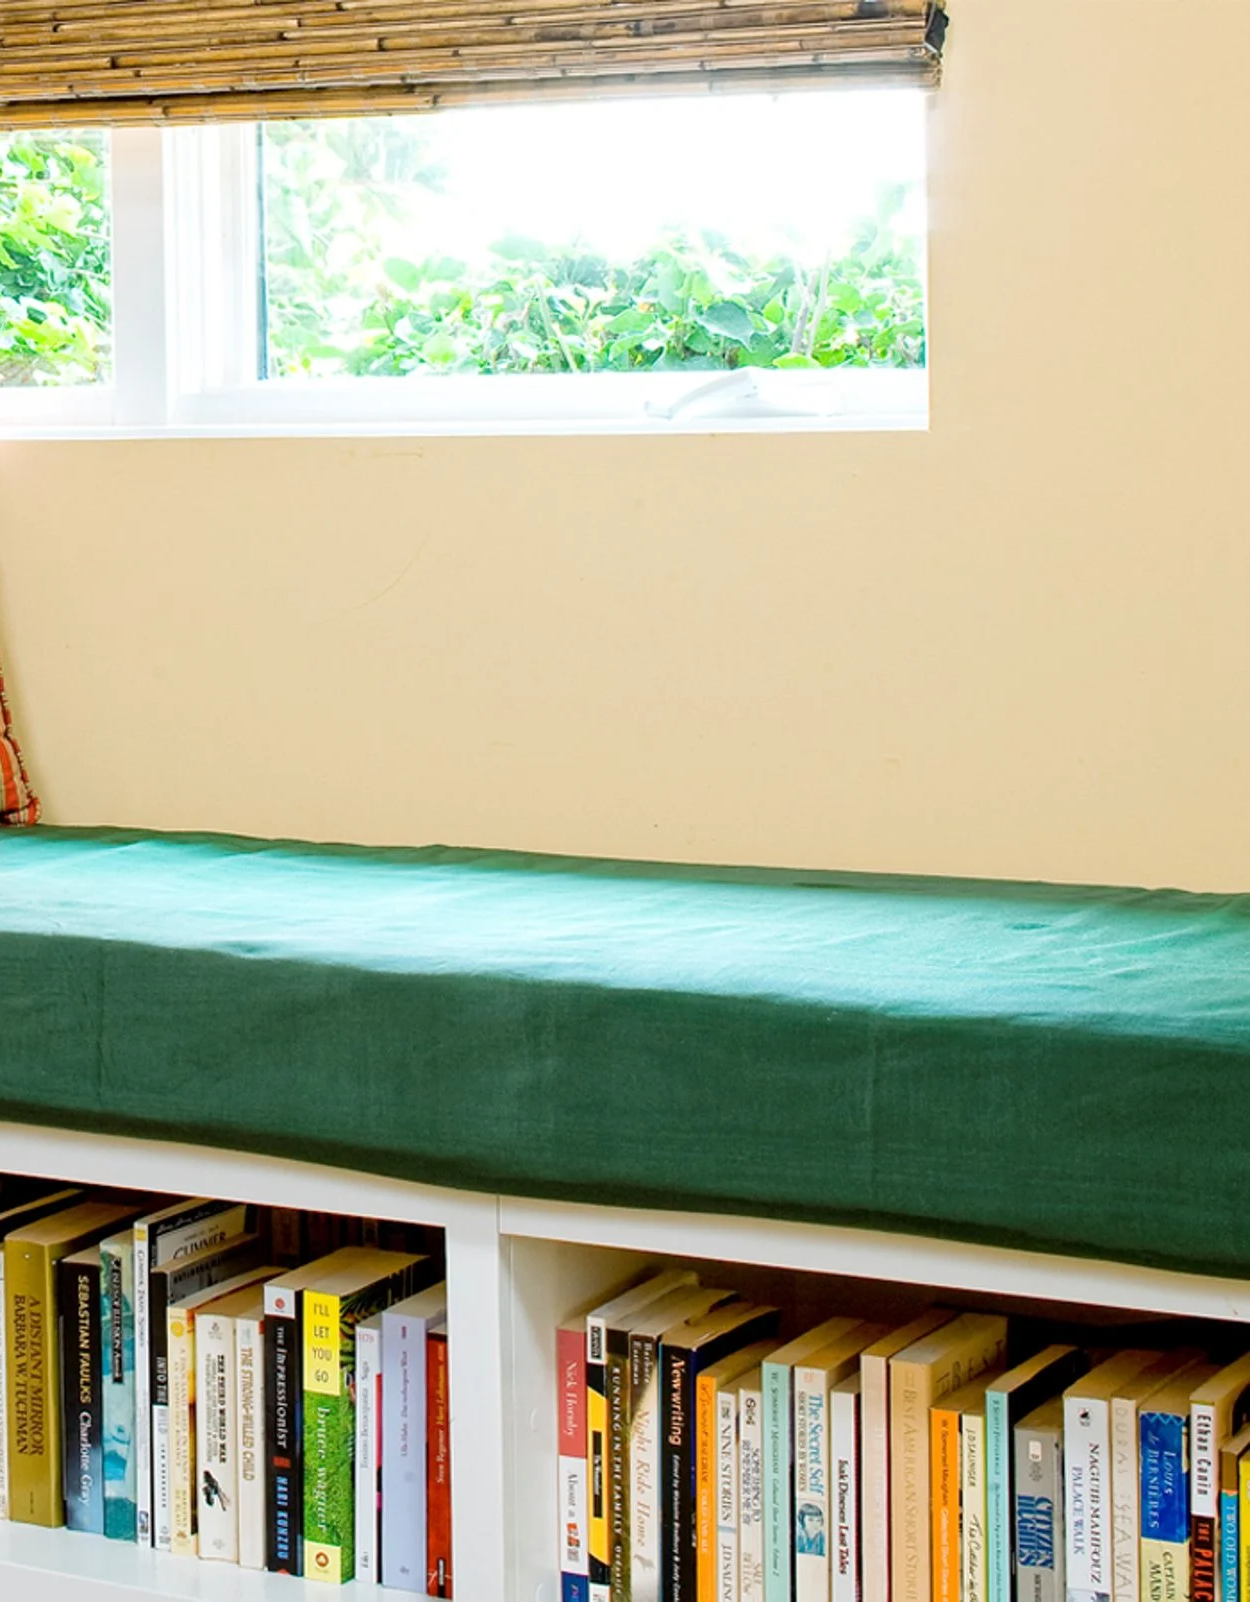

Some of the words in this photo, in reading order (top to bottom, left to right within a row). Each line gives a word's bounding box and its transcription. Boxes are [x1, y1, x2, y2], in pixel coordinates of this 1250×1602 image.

[29, 1296, 42, 1308] A
[77, 1275, 91, 1348] SEBASTIAN
[313, 1302, 330, 1318] I'LL
[13, 1295, 27, 1358] BARBARA
[313, 1325, 330, 1339] LET
[29, 1311, 43, 1382] DISTANT
[240, 1348, 253, 1366] THE
[312, 1348, 333, 1363] YOU
[15, 1364, 28, 1378] W.
[79, 1352, 92, 1404] FAULKS
[155, 1356, 168, 1382] INTO
[314, 1369, 330, 1384] GO
[565, 1360, 578, 1387] Nick
[156, 1384, 169, 1403] THE
[241, 1369, 255, 1449] STRONG-WILLED
[611, 1367, 622, 1431] RUNNING
[797, 1391, 807, 1416] SHORT
[808, 1394, 824, 1421] The
[903, 1389, 918, 1419] BEST
[16, 1380, 30, 1455] TUCHMAN
[30, 1385, 45, 1456] MIRROR
[157, 1408, 169, 1435] WILD
[564, 1392, 579, 1436] Hornby
[634, 1409, 651, 1452] Night
[80, 1411, 94, 1469] Charlotte
[316, 1405, 330, 1462] bruce
[721, 1424, 732, 1460] NINE
[808, 1422, 824, 1465] Secret
[1115, 1407, 1129, 1473] DURAS
[1197, 1414, 1212, 1451] Ethan
[242, 1451, 256, 1481] CHILD
[635, 1459, 651, 1494] Ride
[838, 1459, 849, 1480] Isak
[903, 1422, 920, 1502] AMERICAN
[1088, 1443, 1101, 1503] NAGUIB
[1197, 1459, 1212, 1496] Canin
[78, 1474, 94, 1506] Gray
[276, 1476, 290, 1505] HARI
[313, 1466, 329, 1533] wagner
[567, 1471, 579, 1505] About
[721, 1462, 733, 1521] STORIES
[809, 1469, 825, 1496] Self
[1071, 1466, 1084, 1516] PALACE
[613, 1485, 623, 1535] FAMILY
[752, 1509, 762, 1522] TO
[838, 1482, 849, 1523] Dinesen
[1225, 1506, 1236, 1533] TWO
[277, 1510, 291, 1560] KUNZRU
[636, 1500, 651, 1547] Home
[838, 1524, 849, 1547] Last
[905, 1504, 920, 1550] SHORT
[968, 1514, 983, 1538] The
[1073, 1519, 1086, 1555] WALK
[1116, 1504, 1133, 1545] SEA
[1198, 1523, 1210, 1541] THE
[838, 1547, 850, 1575] Tales
[1090, 1507, 1102, 1584] MAHFOUZ
[1226, 1537, 1236, 1564] OLD
[1163, 1551, 1176, 1601] CAPTAIN
